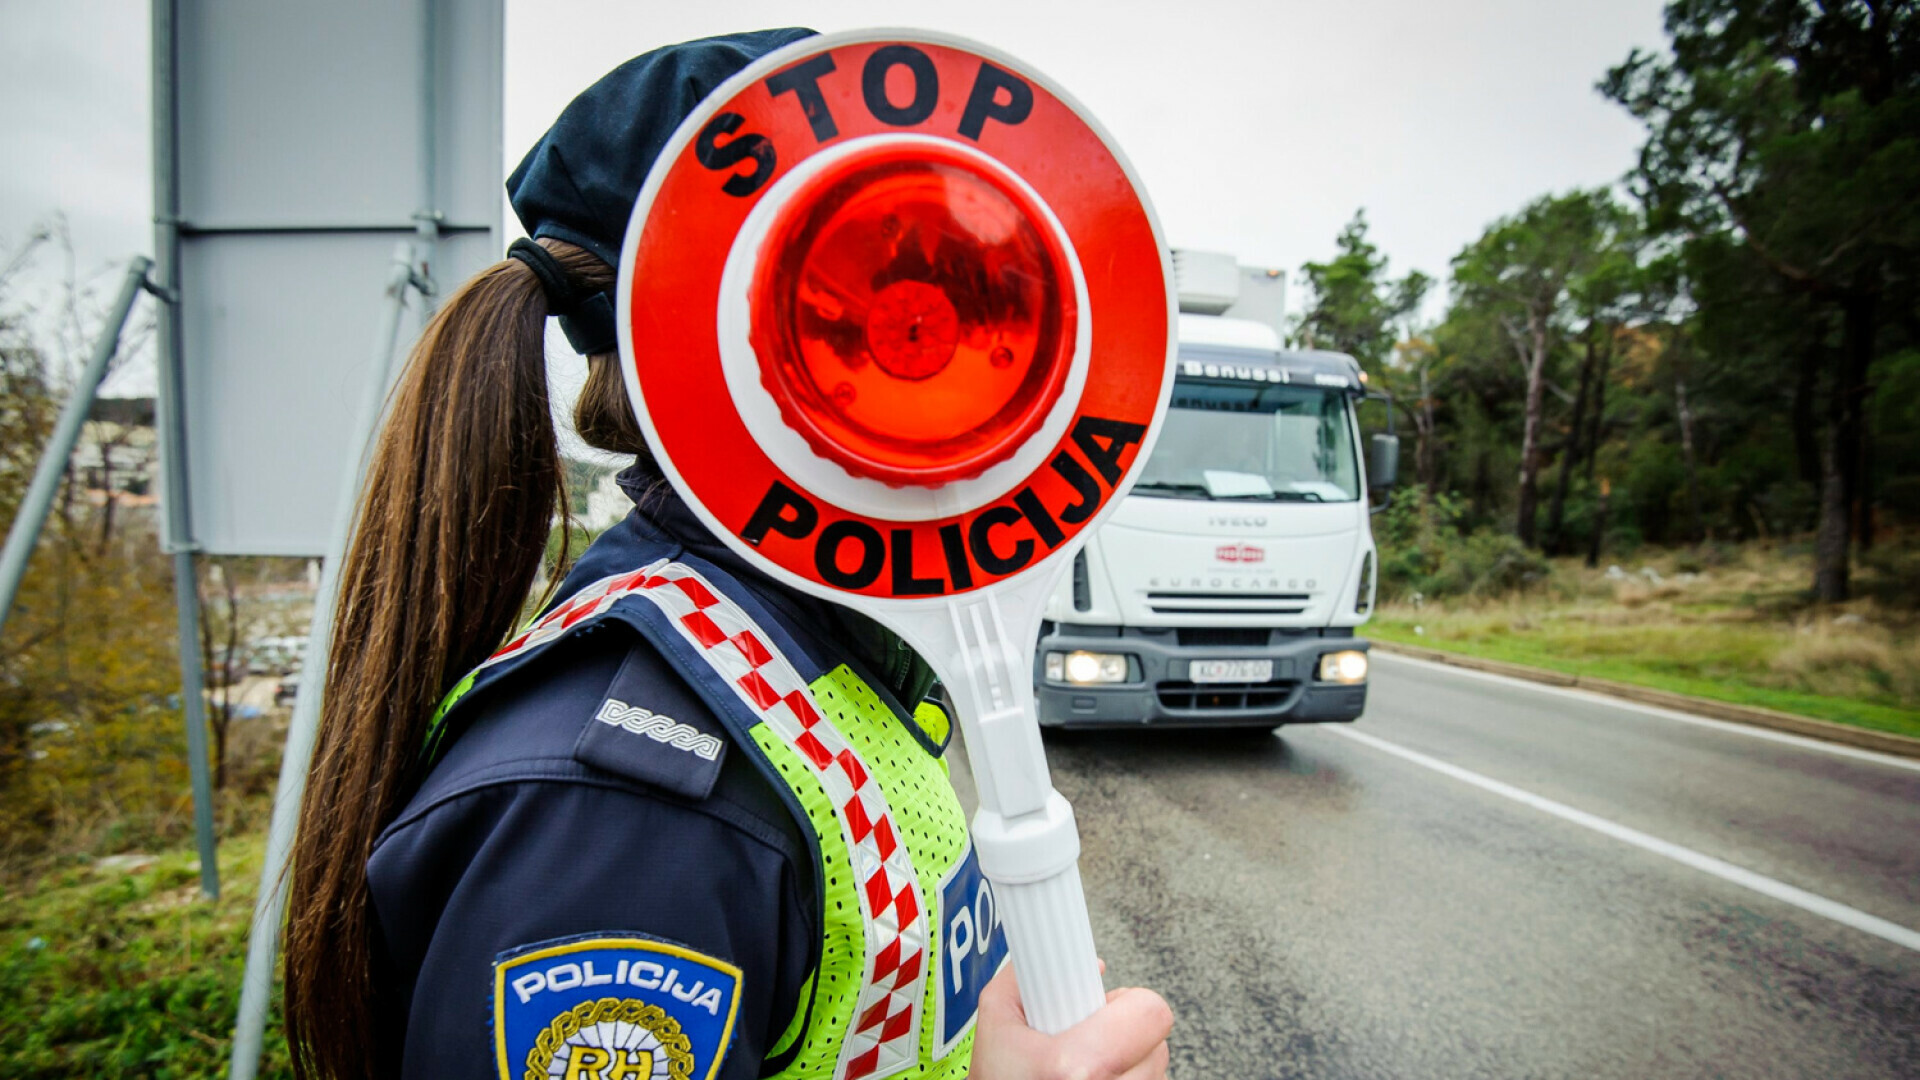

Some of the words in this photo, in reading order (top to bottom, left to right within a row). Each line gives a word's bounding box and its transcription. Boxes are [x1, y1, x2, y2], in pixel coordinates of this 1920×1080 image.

[694, 45, 1034, 198] STOP
[1184, 360, 1290, 384] Benussi
[740, 415, 1148, 595] POLICIJA
[1208, 516, 1268, 527] IVECO
[1149, 577, 1318, 589] EUROCARGO
[950, 878, 1001, 995] PO
[512, 960, 722, 1016] POLICIJA
[563, 1045, 654, 1080] RH
